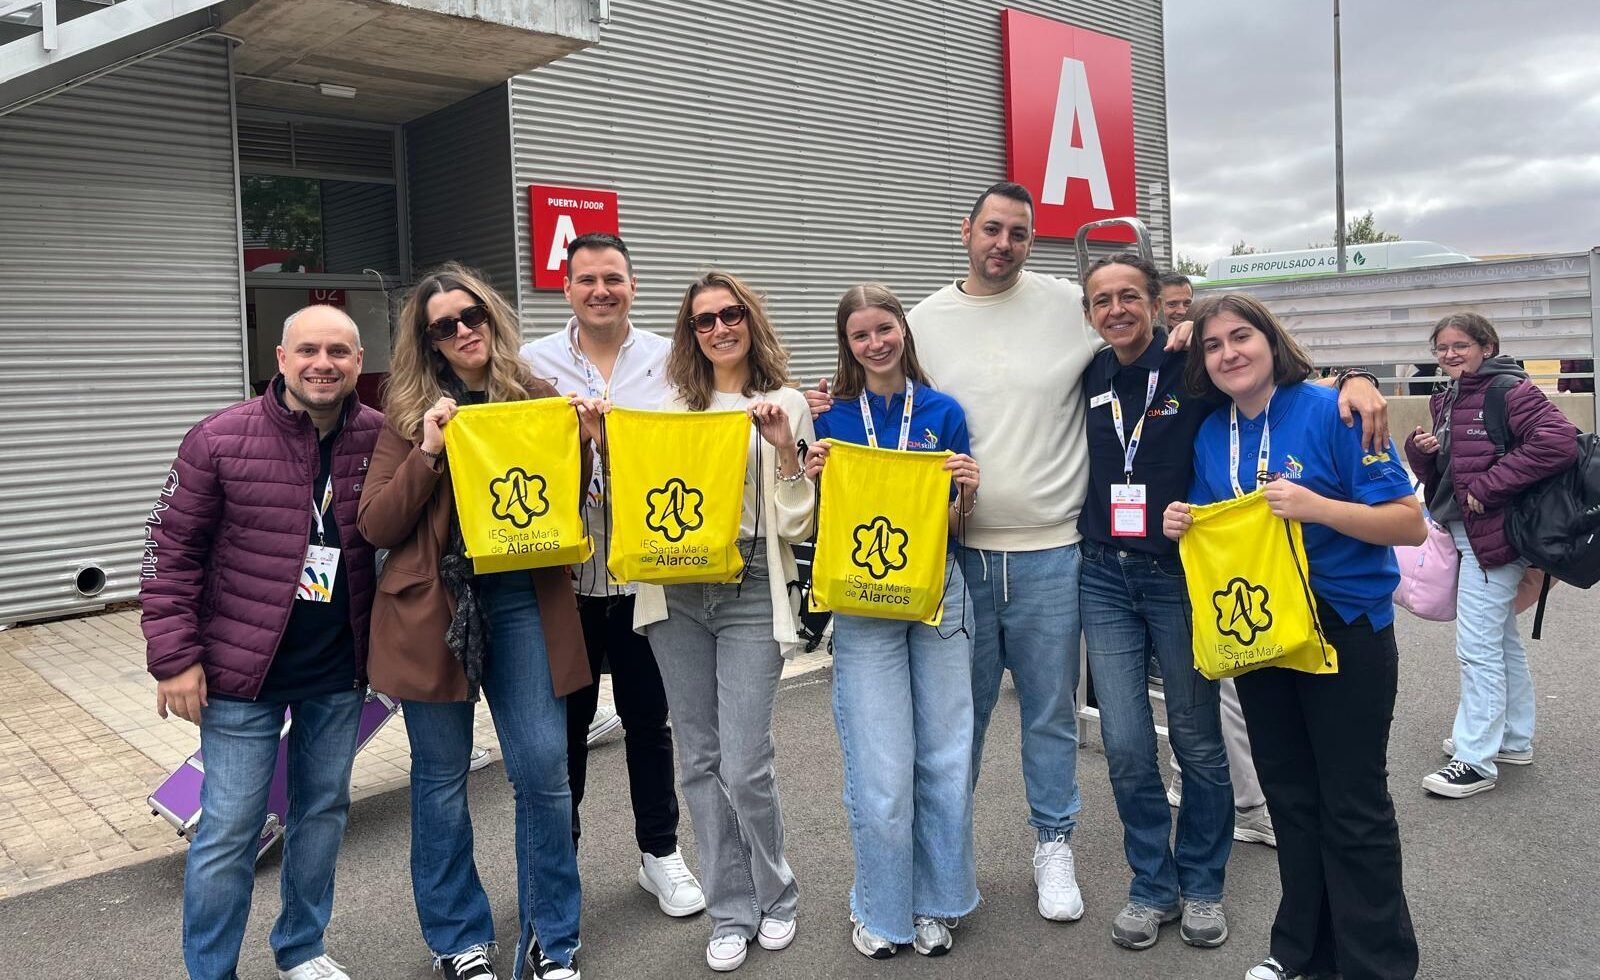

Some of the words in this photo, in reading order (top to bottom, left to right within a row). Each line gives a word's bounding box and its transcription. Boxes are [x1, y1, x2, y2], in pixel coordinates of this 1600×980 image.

[1041, 57, 1114, 210] A
[547, 197, 578, 209] PUERTA
[546, 214, 577, 270] A
[1230, 264, 1249, 274] BUS
[1251, 258, 1315, 272] PROPULSADO
[1317, 257, 1325, 266] A
[1147, 408, 1178, 417] CLMskills
[531, 527, 559, 540] María
[491, 545, 502, 553] de
[507, 540, 560, 555] Alarcos
[682, 543, 709, 553] María
[641, 555, 653, 563] de
[655, 555, 708, 566] Alarcos
[885, 583, 912, 594] María
[845, 589, 857, 597] de
[859, 590, 910, 605] Alarcos
